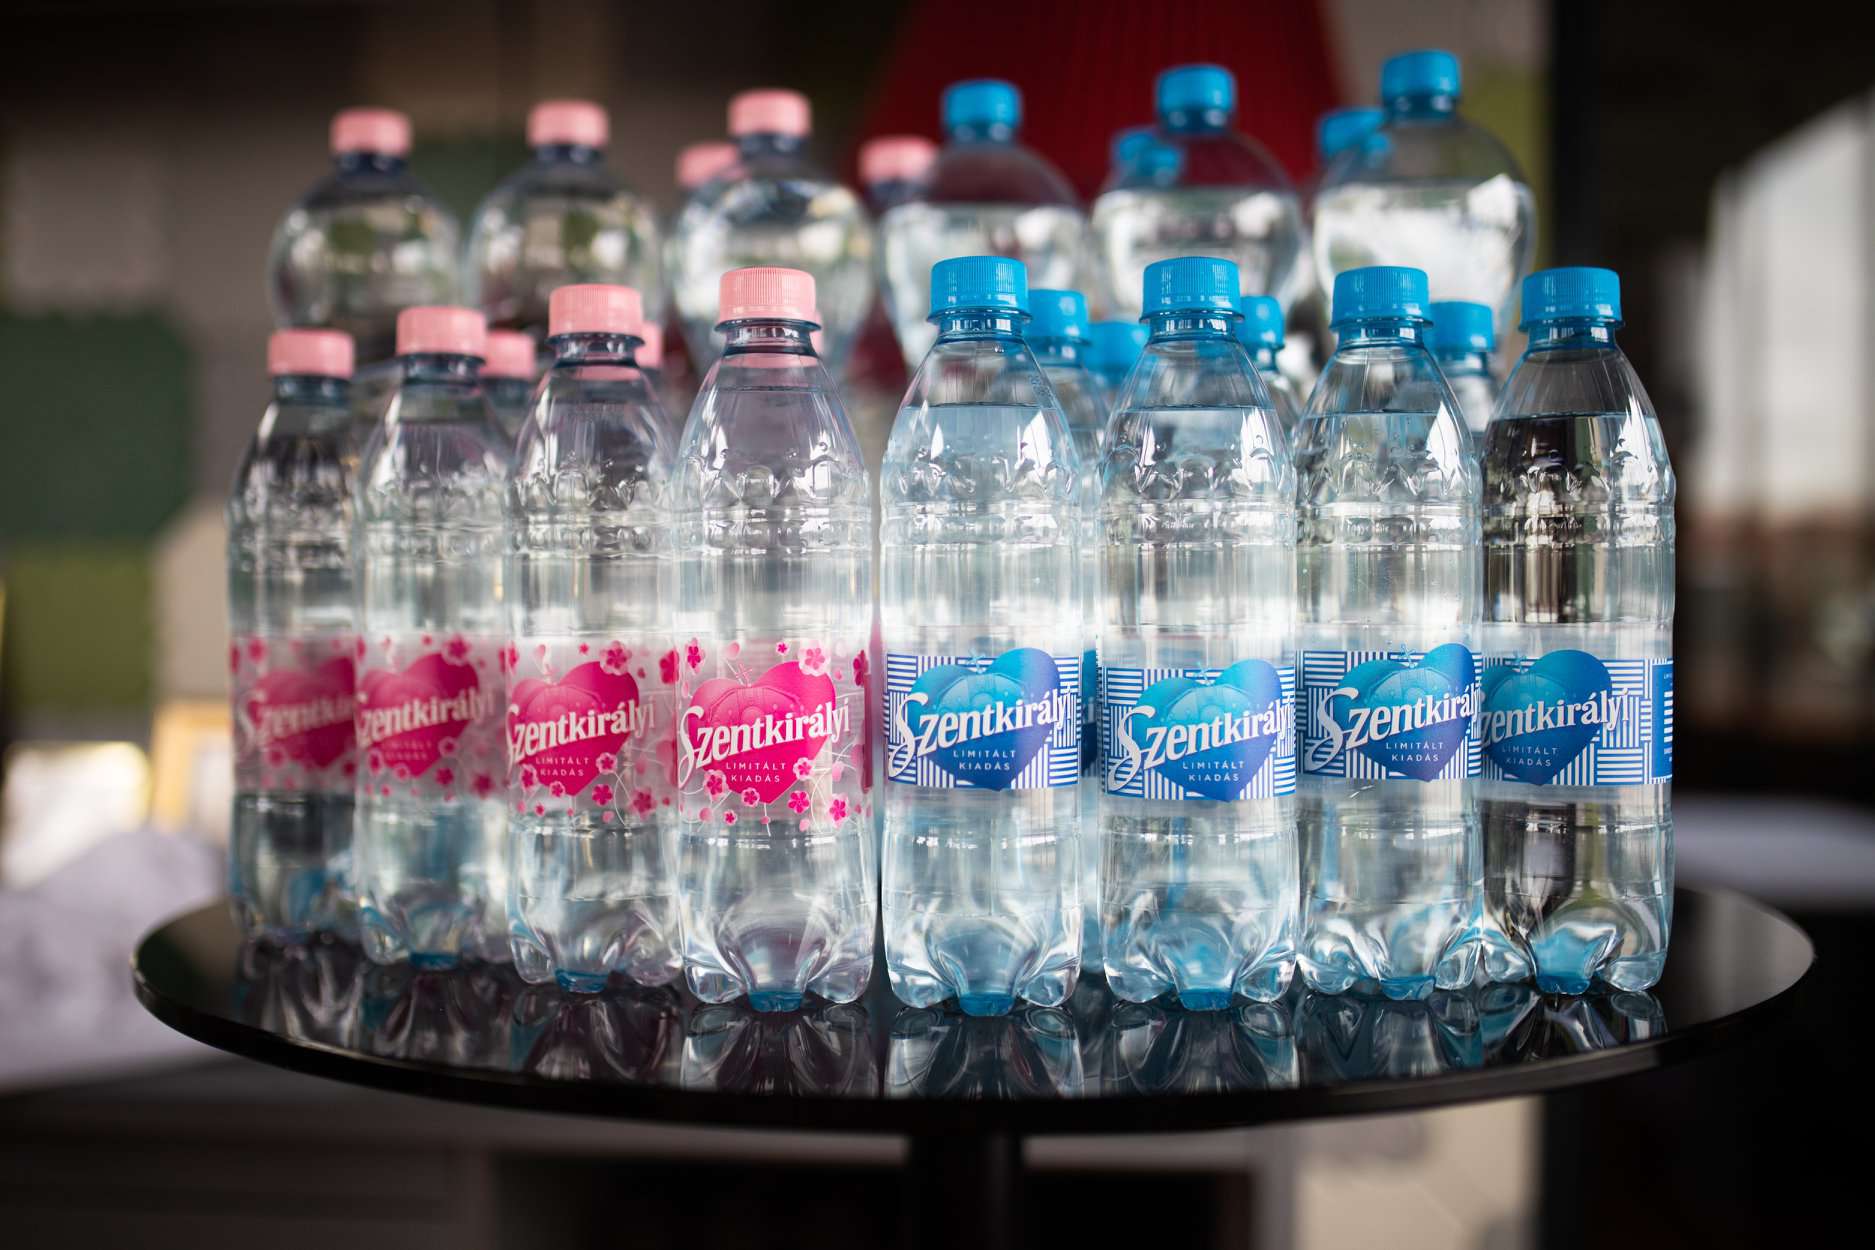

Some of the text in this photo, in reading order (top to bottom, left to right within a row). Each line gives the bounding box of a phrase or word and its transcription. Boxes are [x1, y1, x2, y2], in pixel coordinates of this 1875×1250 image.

[1479, 687, 1629, 748] zentkirályi
[888, 685, 1072, 778] Szentkirályi
[505, 696, 656, 782] Szentkirályi
[678, 697, 850, 789] Szentkirályi
[1385, 740, 1445, 750] LIMITÁLT
[953, 749, 1017, 759] LIMITÁLT
[1391, 752, 1440, 762] KIADÁS
[725, 760, 787, 770] LIMITÁLT
[958, 760, 1011, 771] KIADÁS
[1182, 760, 1245, 770] LIMITÁLT
[730, 772, 781, 783] KIADÁS
[1188, 771, 1240, 782] KIADÁS
